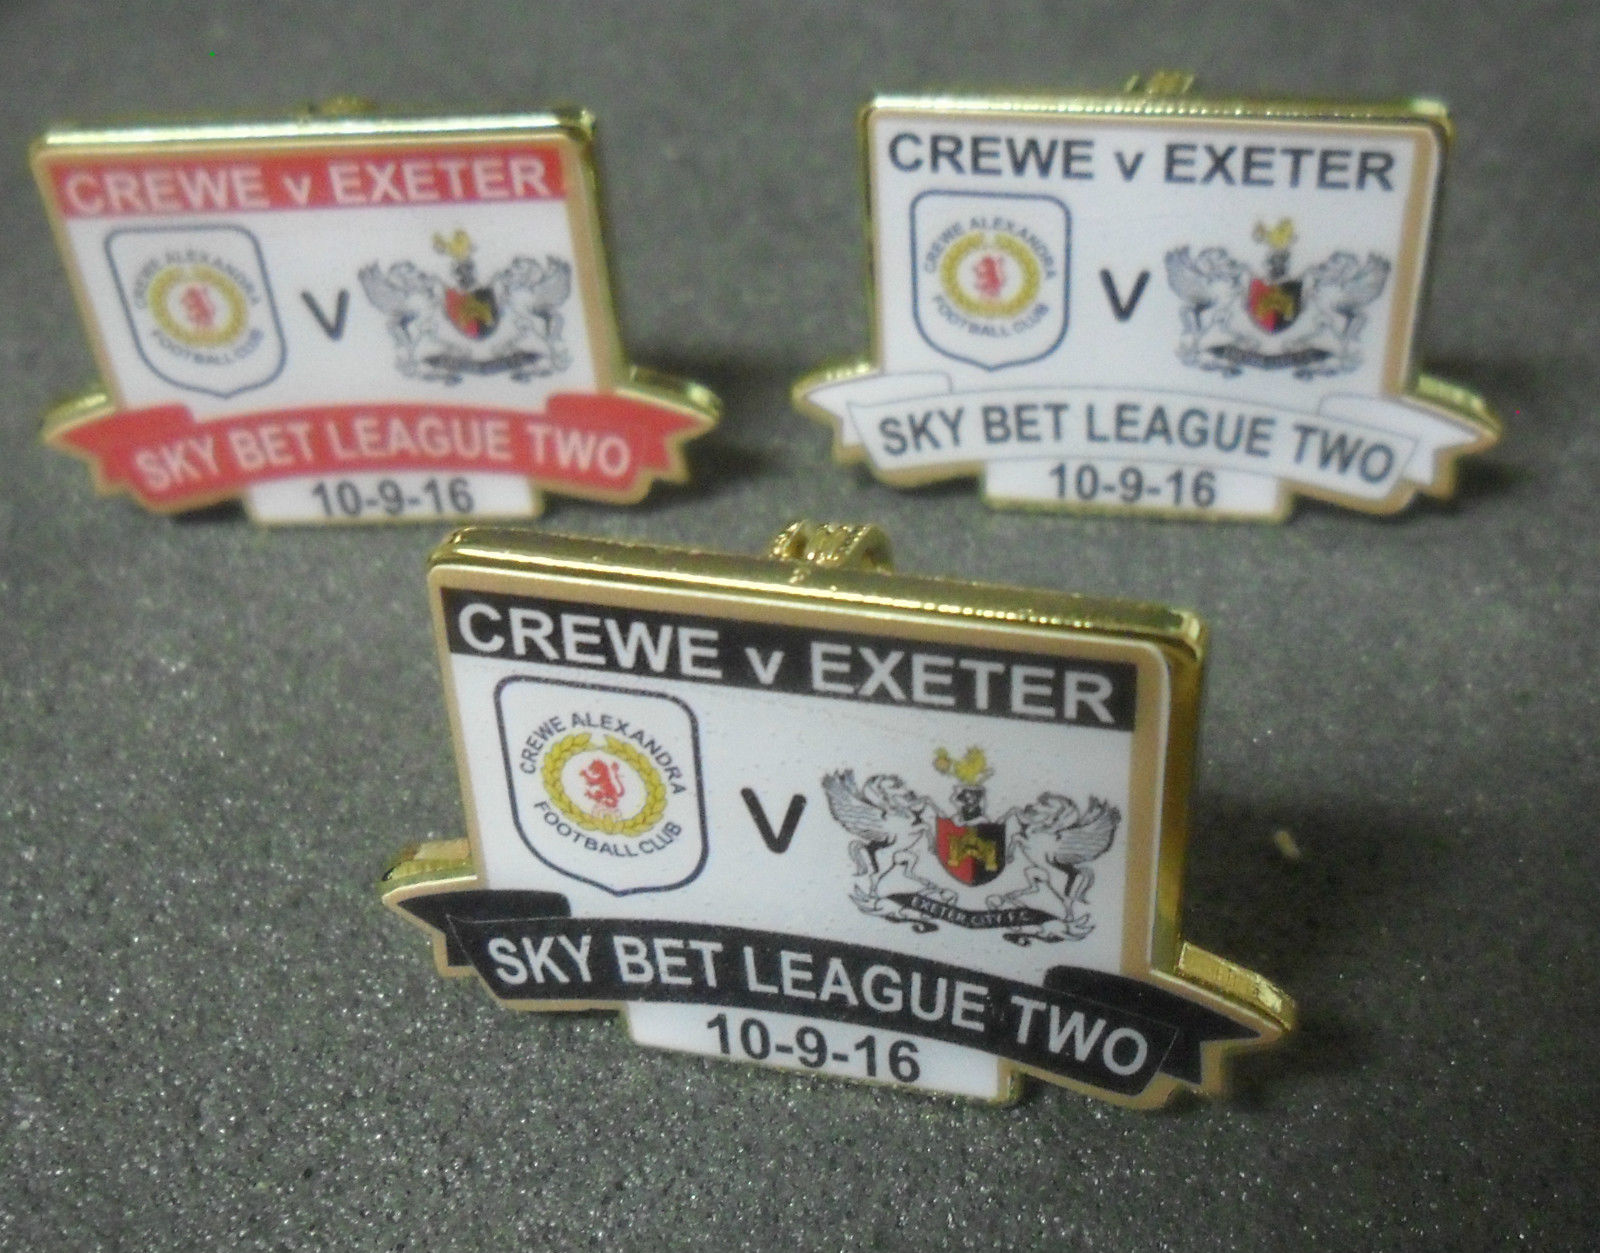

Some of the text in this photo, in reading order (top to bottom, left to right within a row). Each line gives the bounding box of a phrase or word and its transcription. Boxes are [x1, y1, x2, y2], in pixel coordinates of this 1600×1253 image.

[65, 155, 551, 213] CREWE v EXETER
[887, 131, 1394, 191] CREWE v EXETER
[134, 415, 631, 492] SKY BET LEAGUE TWO
[879, 402, 1395, 484] SKY BET LEAGUE TWO
[313, 477, 475, 517] 10-9-16
[1050, 466, 1216, 508] 10-9-16
[457, 603, 1113, 724] CREWE v EXETER
[520, 713, 686, 794] CREWE ALEXANDRA
[534, 801, 682, 857] FOOTBALL CLUB
[487, 935, 1149, 1078] SKY BET LEAGUE TWO
[706, 1014, 921, 1083] 10-9-16
